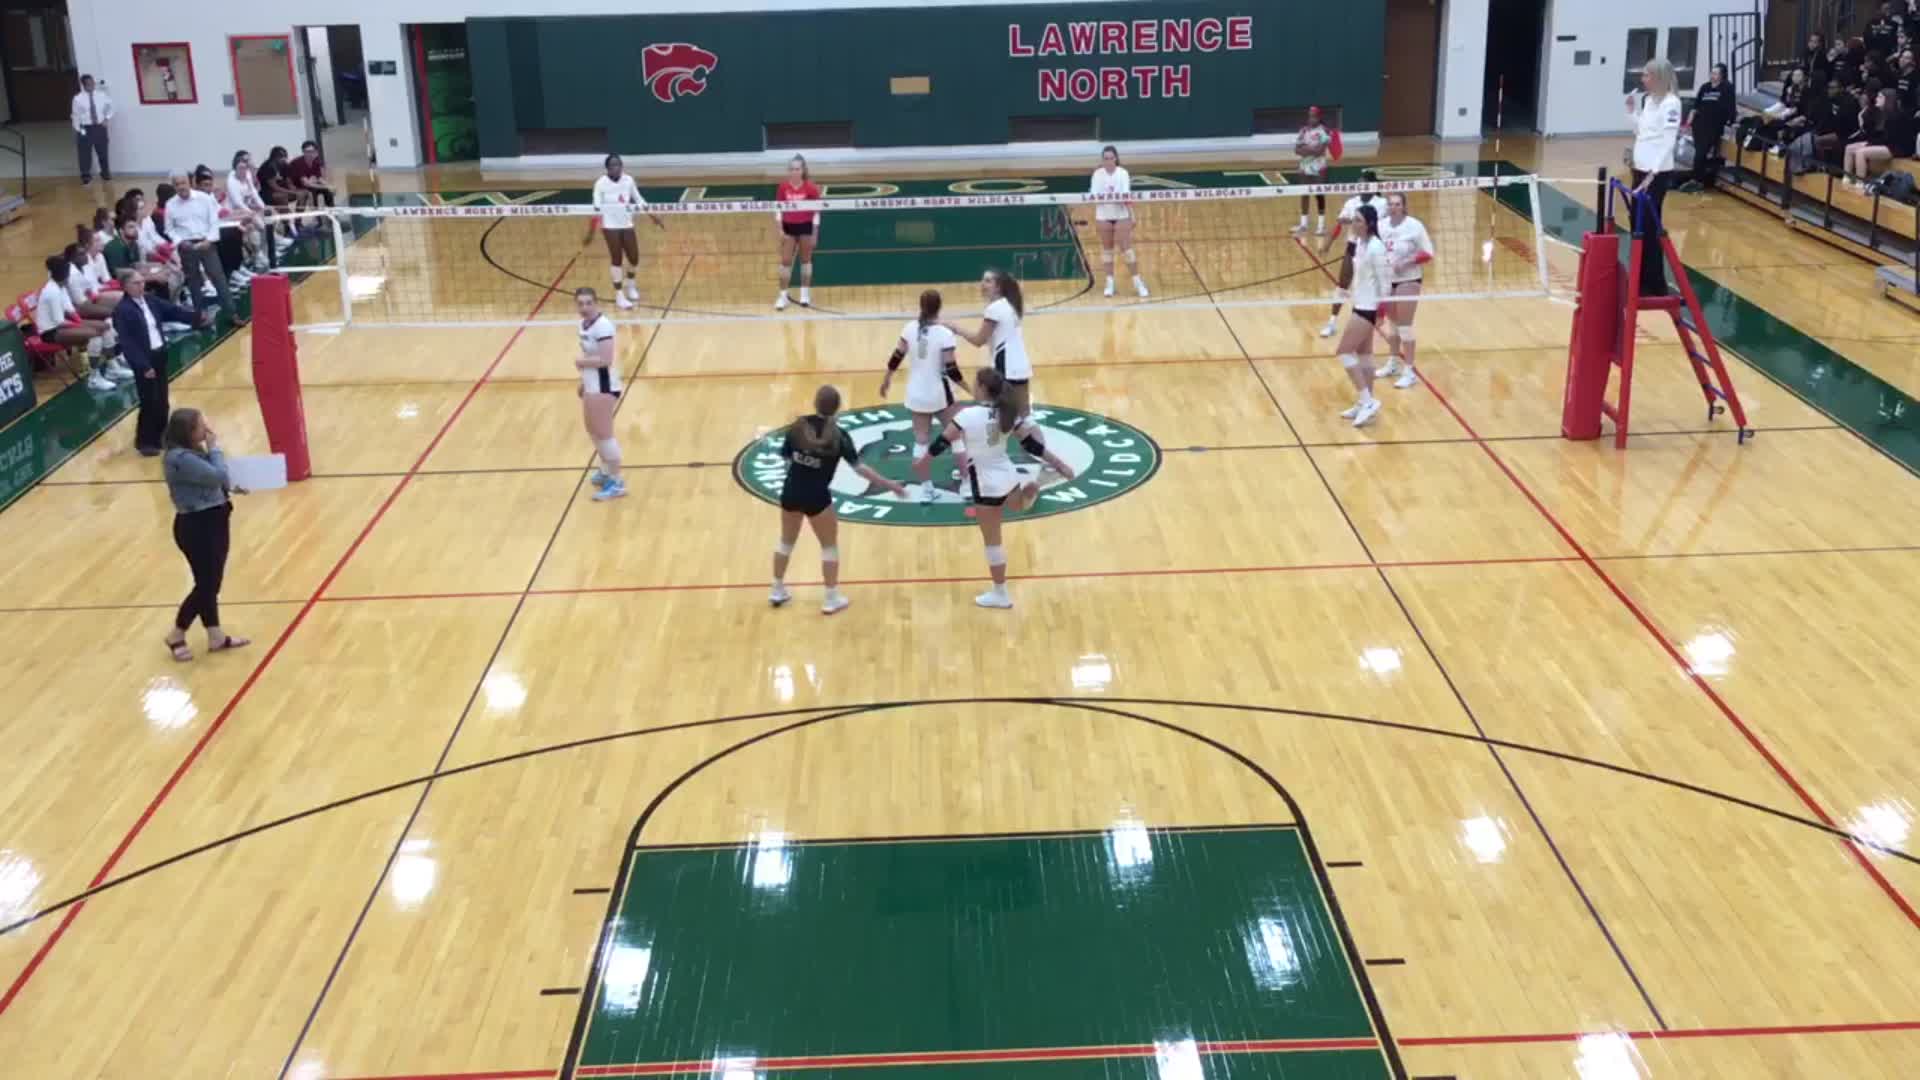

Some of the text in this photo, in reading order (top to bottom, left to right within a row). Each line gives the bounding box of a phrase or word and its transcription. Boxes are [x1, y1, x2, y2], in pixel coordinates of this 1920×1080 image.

[1008, 16, 1253, 57] LAWRENCE
[1038, 65, 1191, 102] NORTH
[1377, 182, 1415, 191] NORTH
[1150, 190, 1187, 200] NORTH
[695, 200, 733, 211] NORTH
[923, 197, 961, 207] NORTH
[464, 206, 502, 215] NORTH
